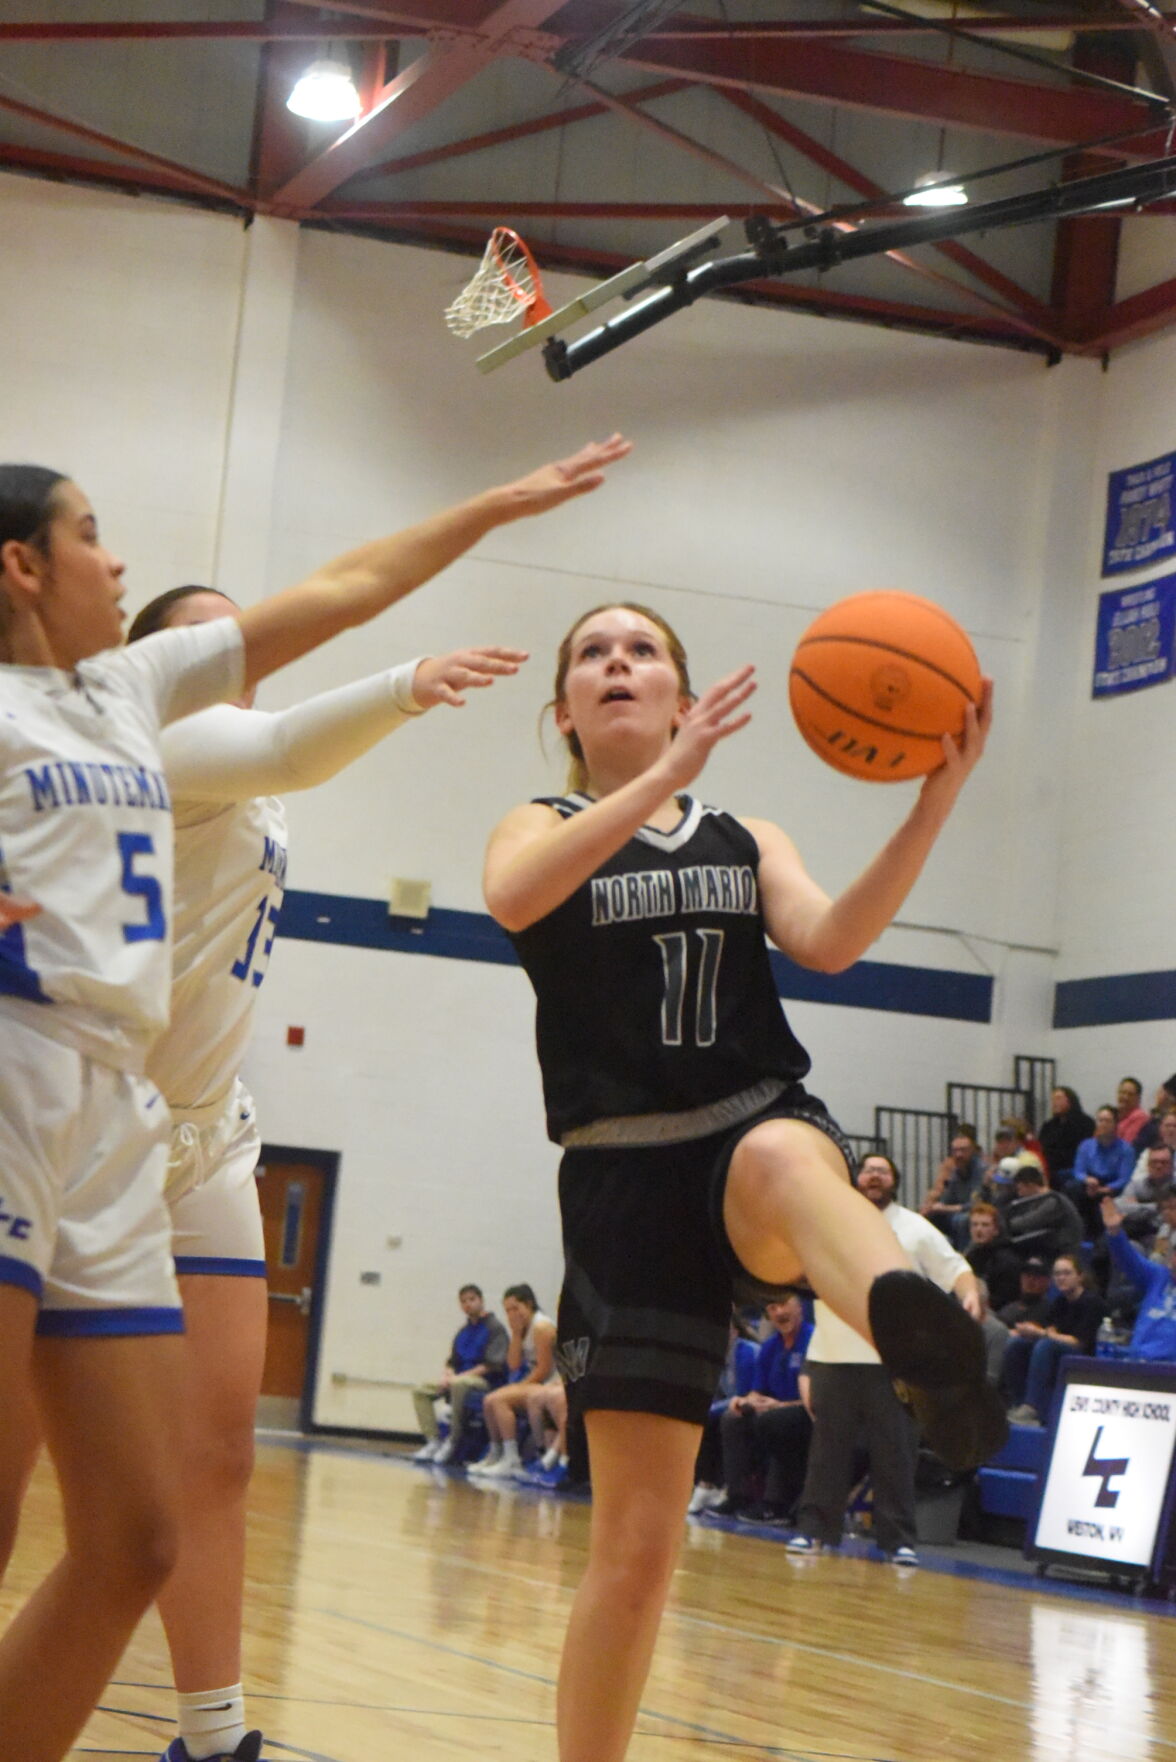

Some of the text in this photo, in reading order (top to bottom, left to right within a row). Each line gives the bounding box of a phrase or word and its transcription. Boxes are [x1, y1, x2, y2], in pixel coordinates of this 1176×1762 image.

[116, 832, 166, 944] 5
[591, 869, 675, 926] NORTH
[652, 928, 725, 1047] 11
[1142, 1402, 1171, 1422] SCHOOL
